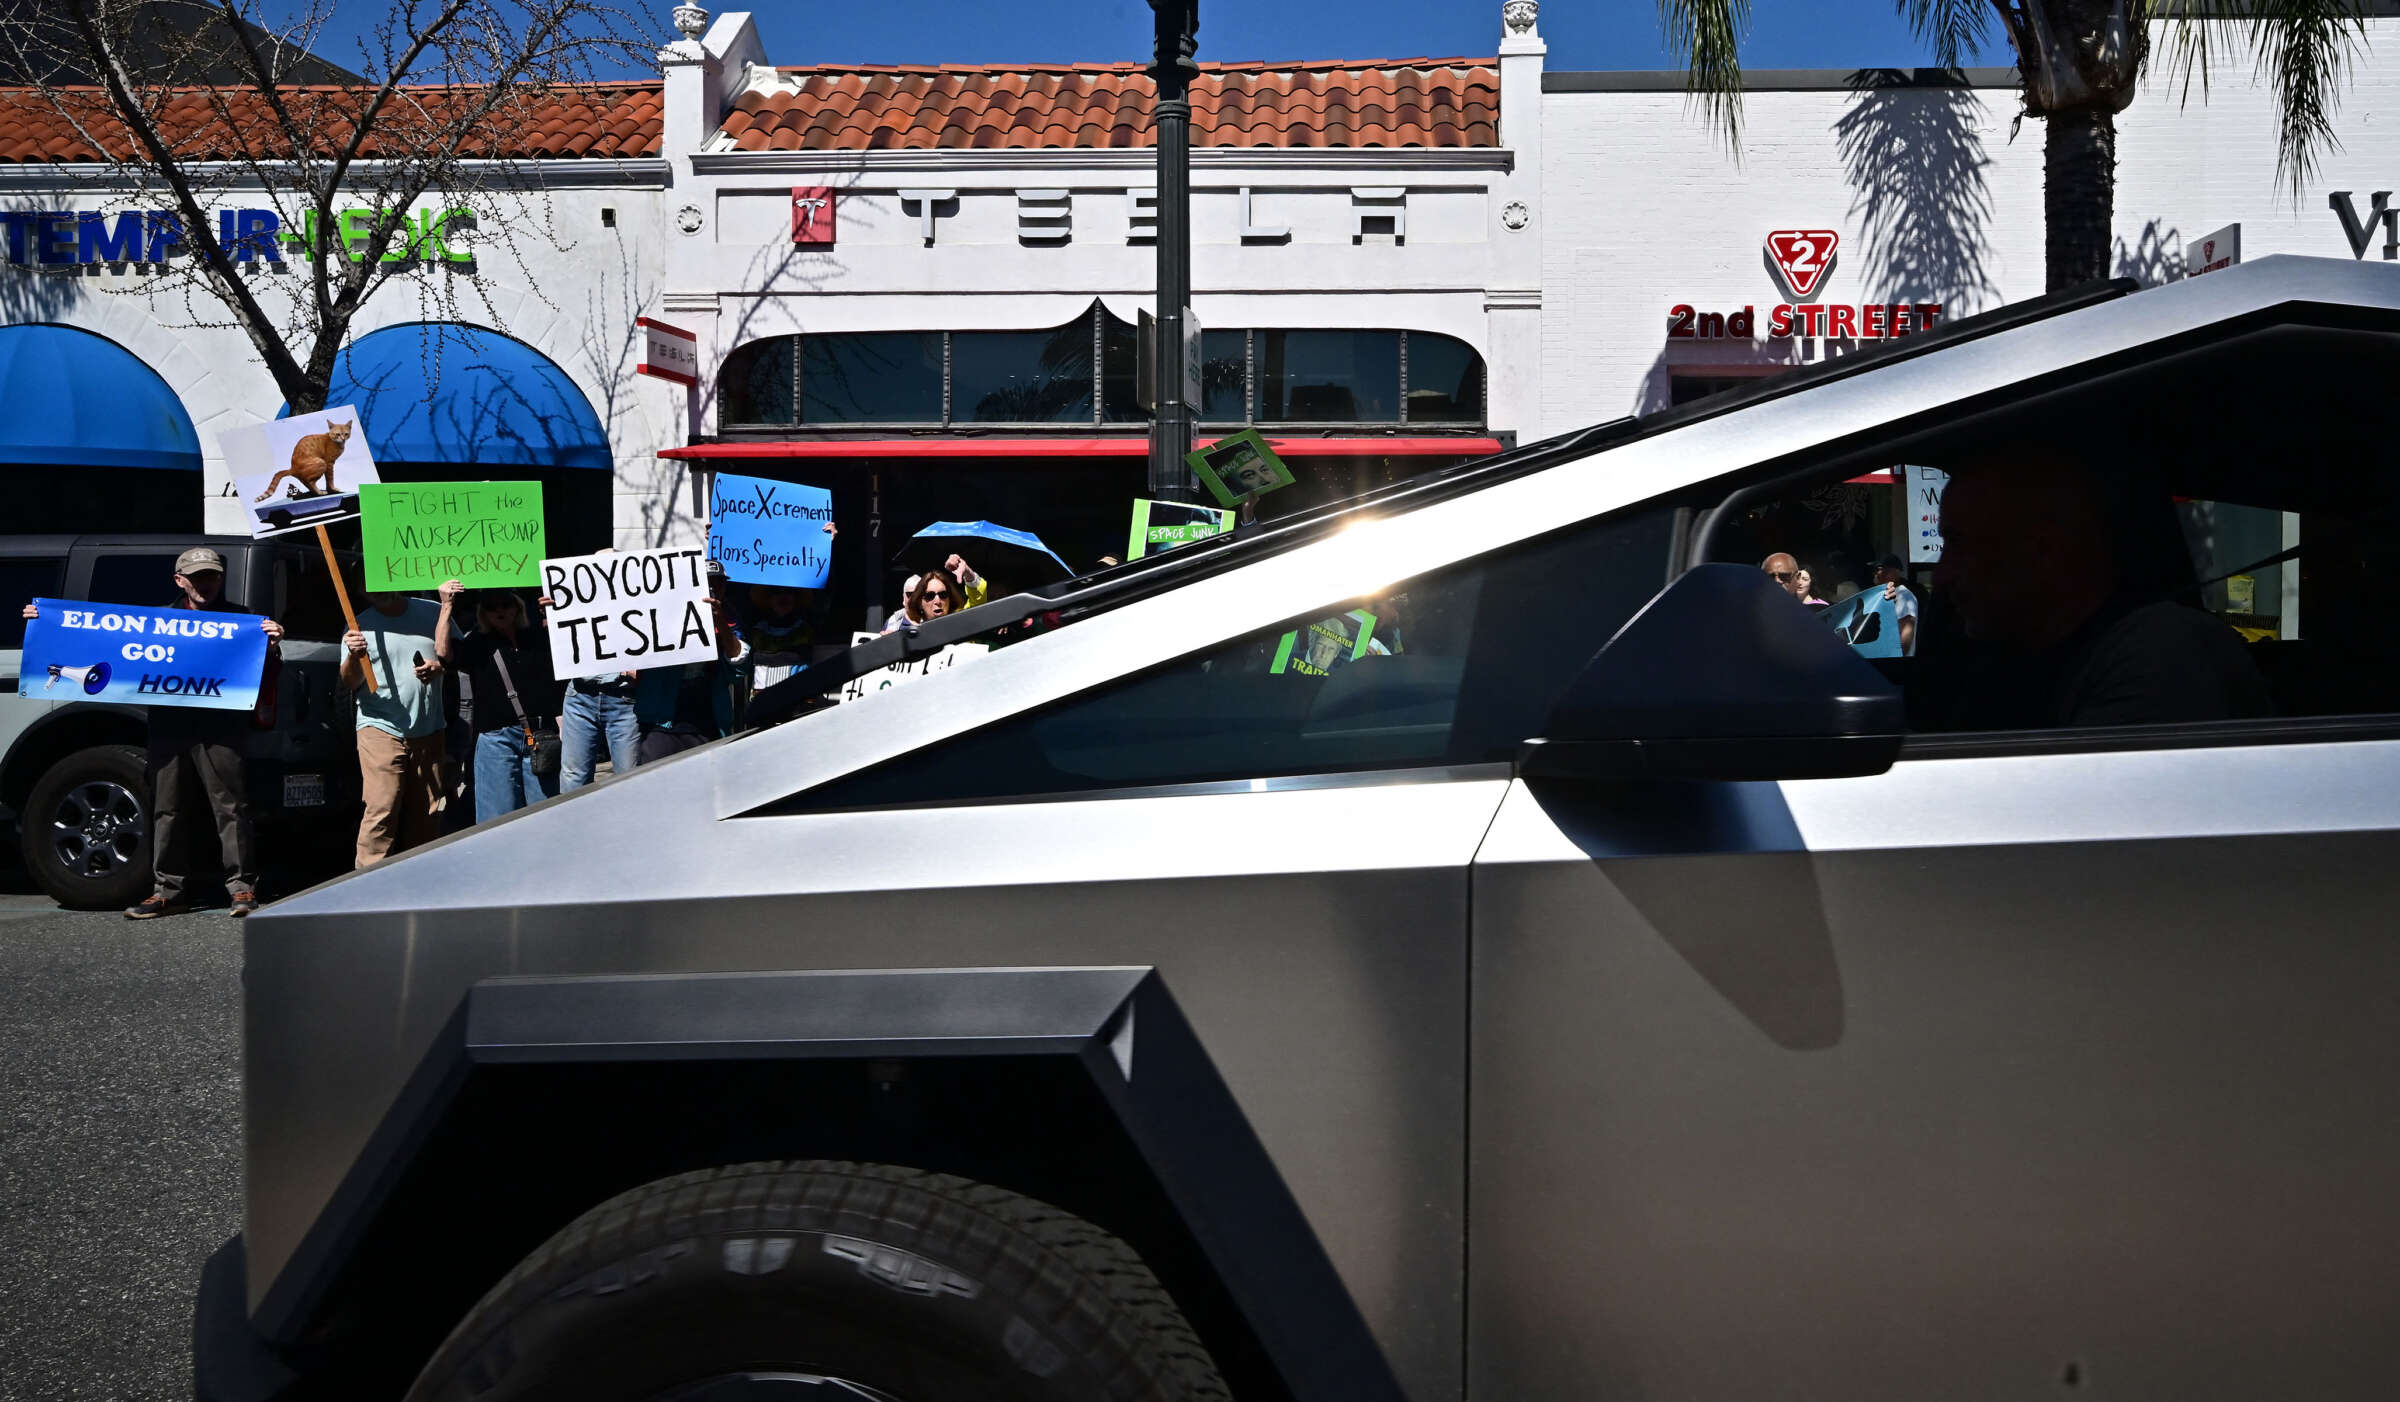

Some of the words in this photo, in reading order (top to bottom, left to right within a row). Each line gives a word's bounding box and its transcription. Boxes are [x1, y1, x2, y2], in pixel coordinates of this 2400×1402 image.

[897, 187, 1406, 241] TESLA
[1790, 240, 1816, 271] 2
[1668, 303, 1754, 339] 2nd
[1769, 303, 1943, 339] STREET
[650, 340, 695, 364] TESLA
[389, 491, 480, 517] FIGHT
[497, 493, 523, 510] the
[713, 478, 832, 523] SpaceXcrement
[393, 518, 539, 549] MUSK/TRUMP
[1150, 527, 1184, 540] SPACE
[1191, 526, 1216, 539] JUNK
[385, 552, 528, 582] KLEPTOCRACY
[754, 538, 827, 577] Specialty
[545, 550, 703, 611] BOYCOTT
[61, 610, 147, 633] ELON
[153, 617, 239, 639] MUST
[557, 600, 710, 664] TESLA
[1310, 623, 1354, 648] OMANHATER
[121, 643, 175, 663] GO!
[1292, 656, 1329, 676] TRAIT
[137, 674, 227, 697] HONK
